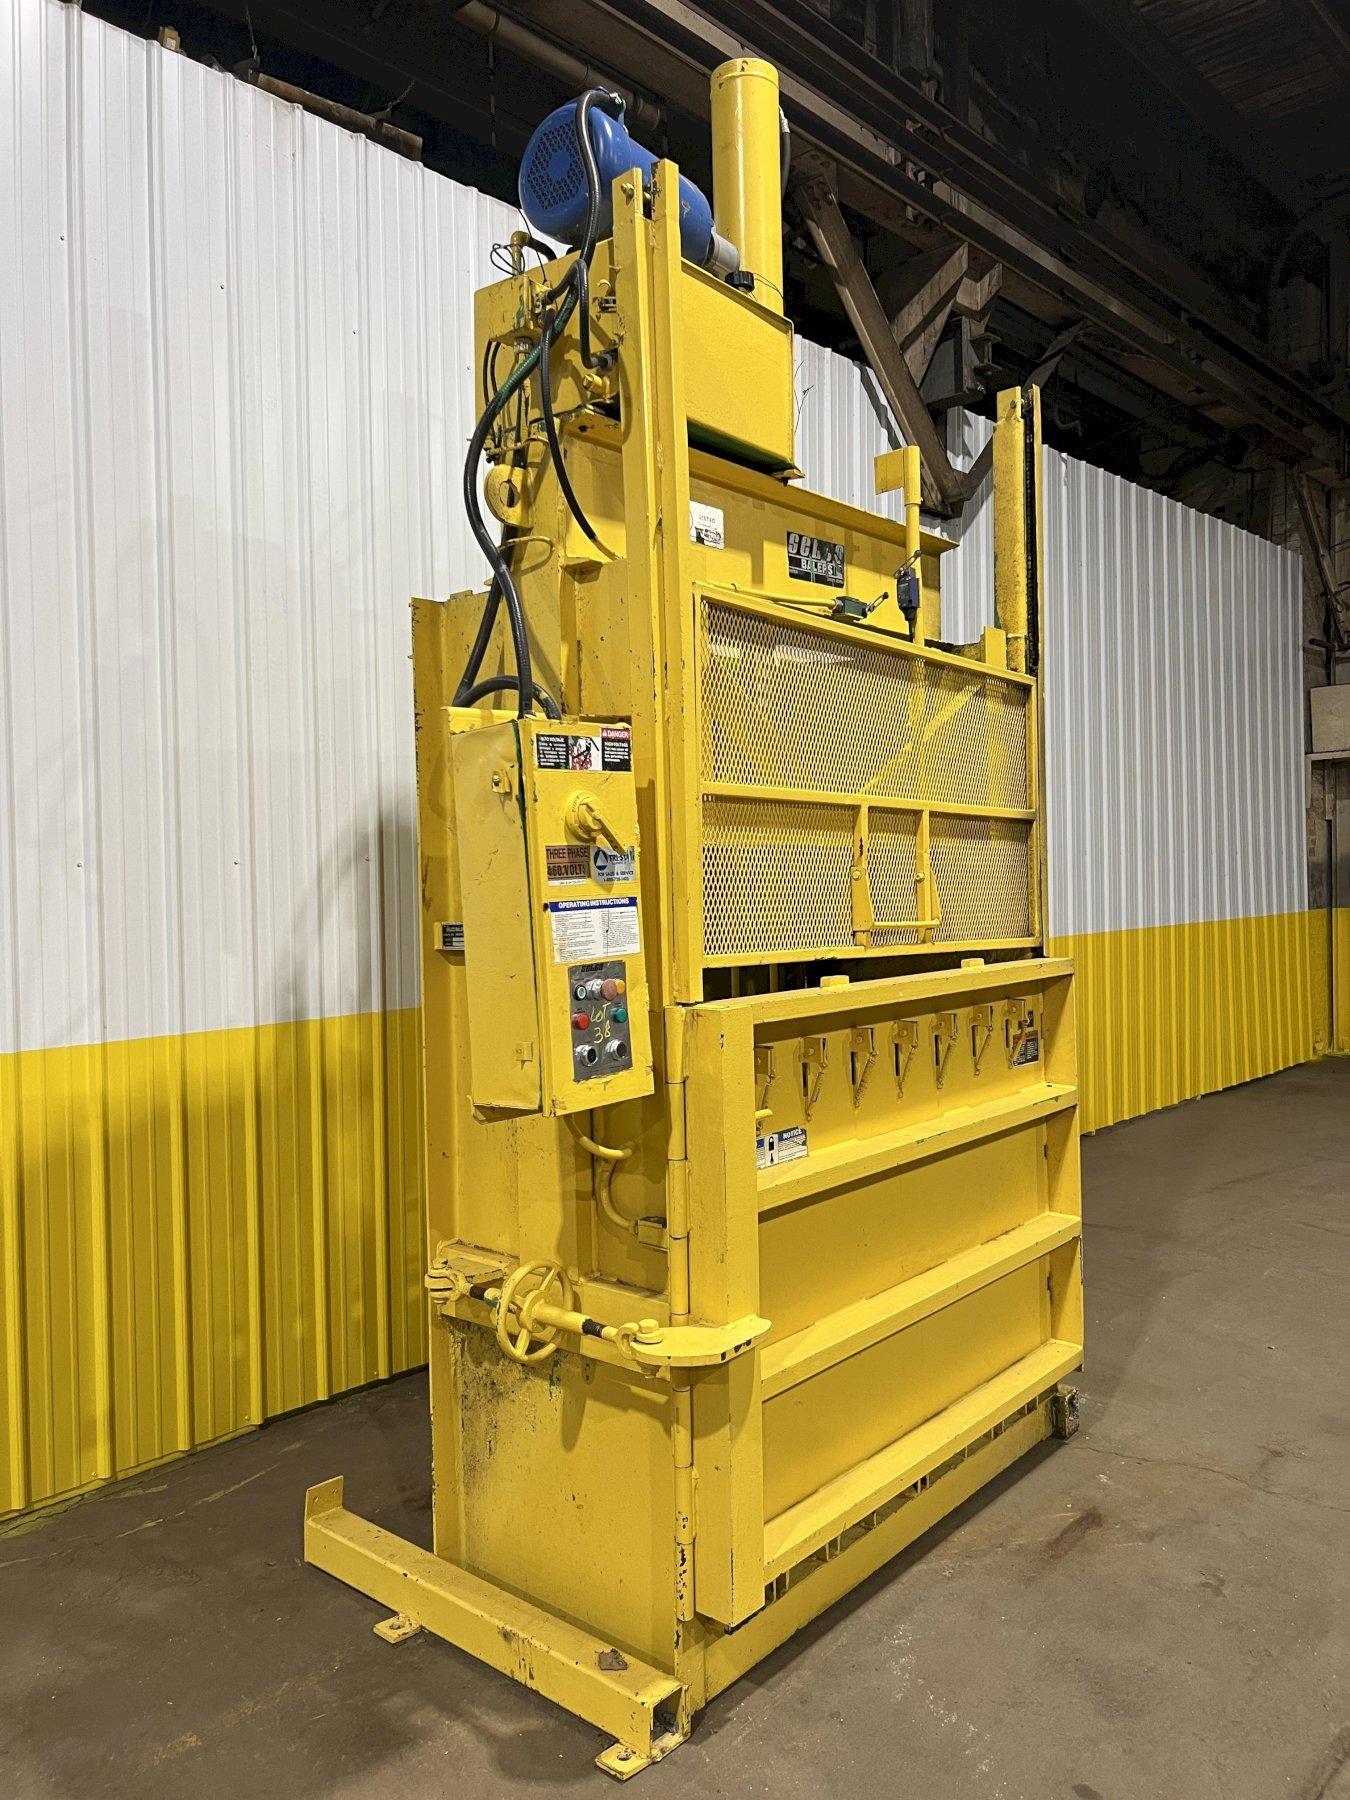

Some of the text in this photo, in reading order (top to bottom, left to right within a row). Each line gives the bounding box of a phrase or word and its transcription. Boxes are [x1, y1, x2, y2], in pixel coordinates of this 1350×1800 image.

[607, 730, 629, 738] DANGER
[546, 847, 588, 860] THREE PHASE
[558, 898, 629, 908] OPERATING INSTRUCTIONS
[590, 1002, 611, 1022] LOT
[594, 1020, 611, 1044] 38
[782, 1129, 802, 1139] NOTICE
